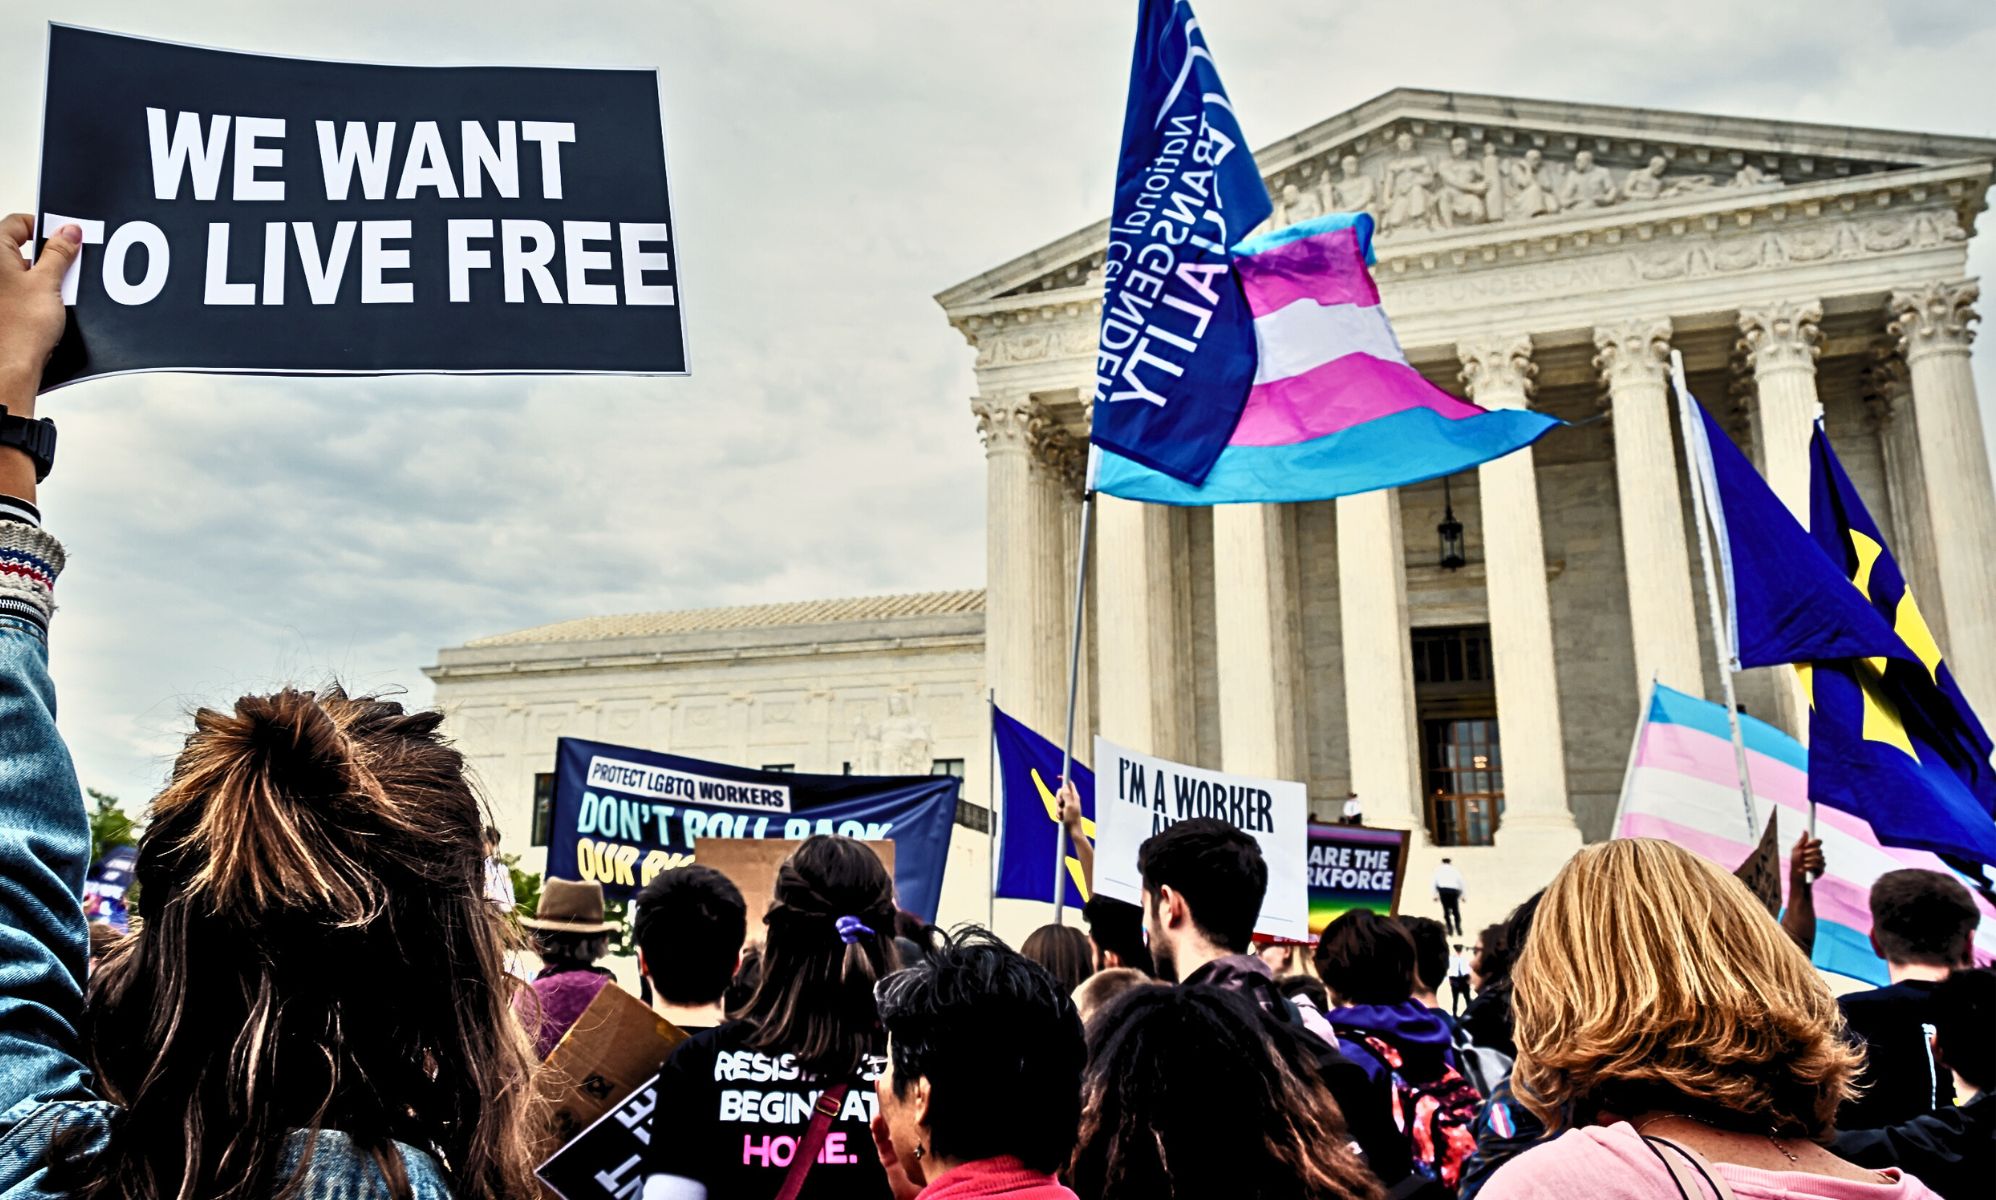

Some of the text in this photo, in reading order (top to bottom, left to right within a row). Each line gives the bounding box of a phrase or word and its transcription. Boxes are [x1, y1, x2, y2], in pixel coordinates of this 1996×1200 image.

[146, 107, 576, 200] WE WANT
[43, 212, 675, 306] TO LIVE FREE
[592, 763, 783, 807] PROTECT LGBTQ WORKERS
[1119, 757, 1146, 807] I'M
[1153, 769, 1165, 813] A
[1174, 774, 1272, 833] WORKER
[577, 791, 673, 845] DON'T
[577, 837, 638, 886] OUR
[1307, 866, 1392, 890] RKFORCE
[1309, 846, 1389, 869] ARE THE
[719, 1090, 879, 1123] BEGIN AT
[743, 1132, 856, 1167] HOE.
